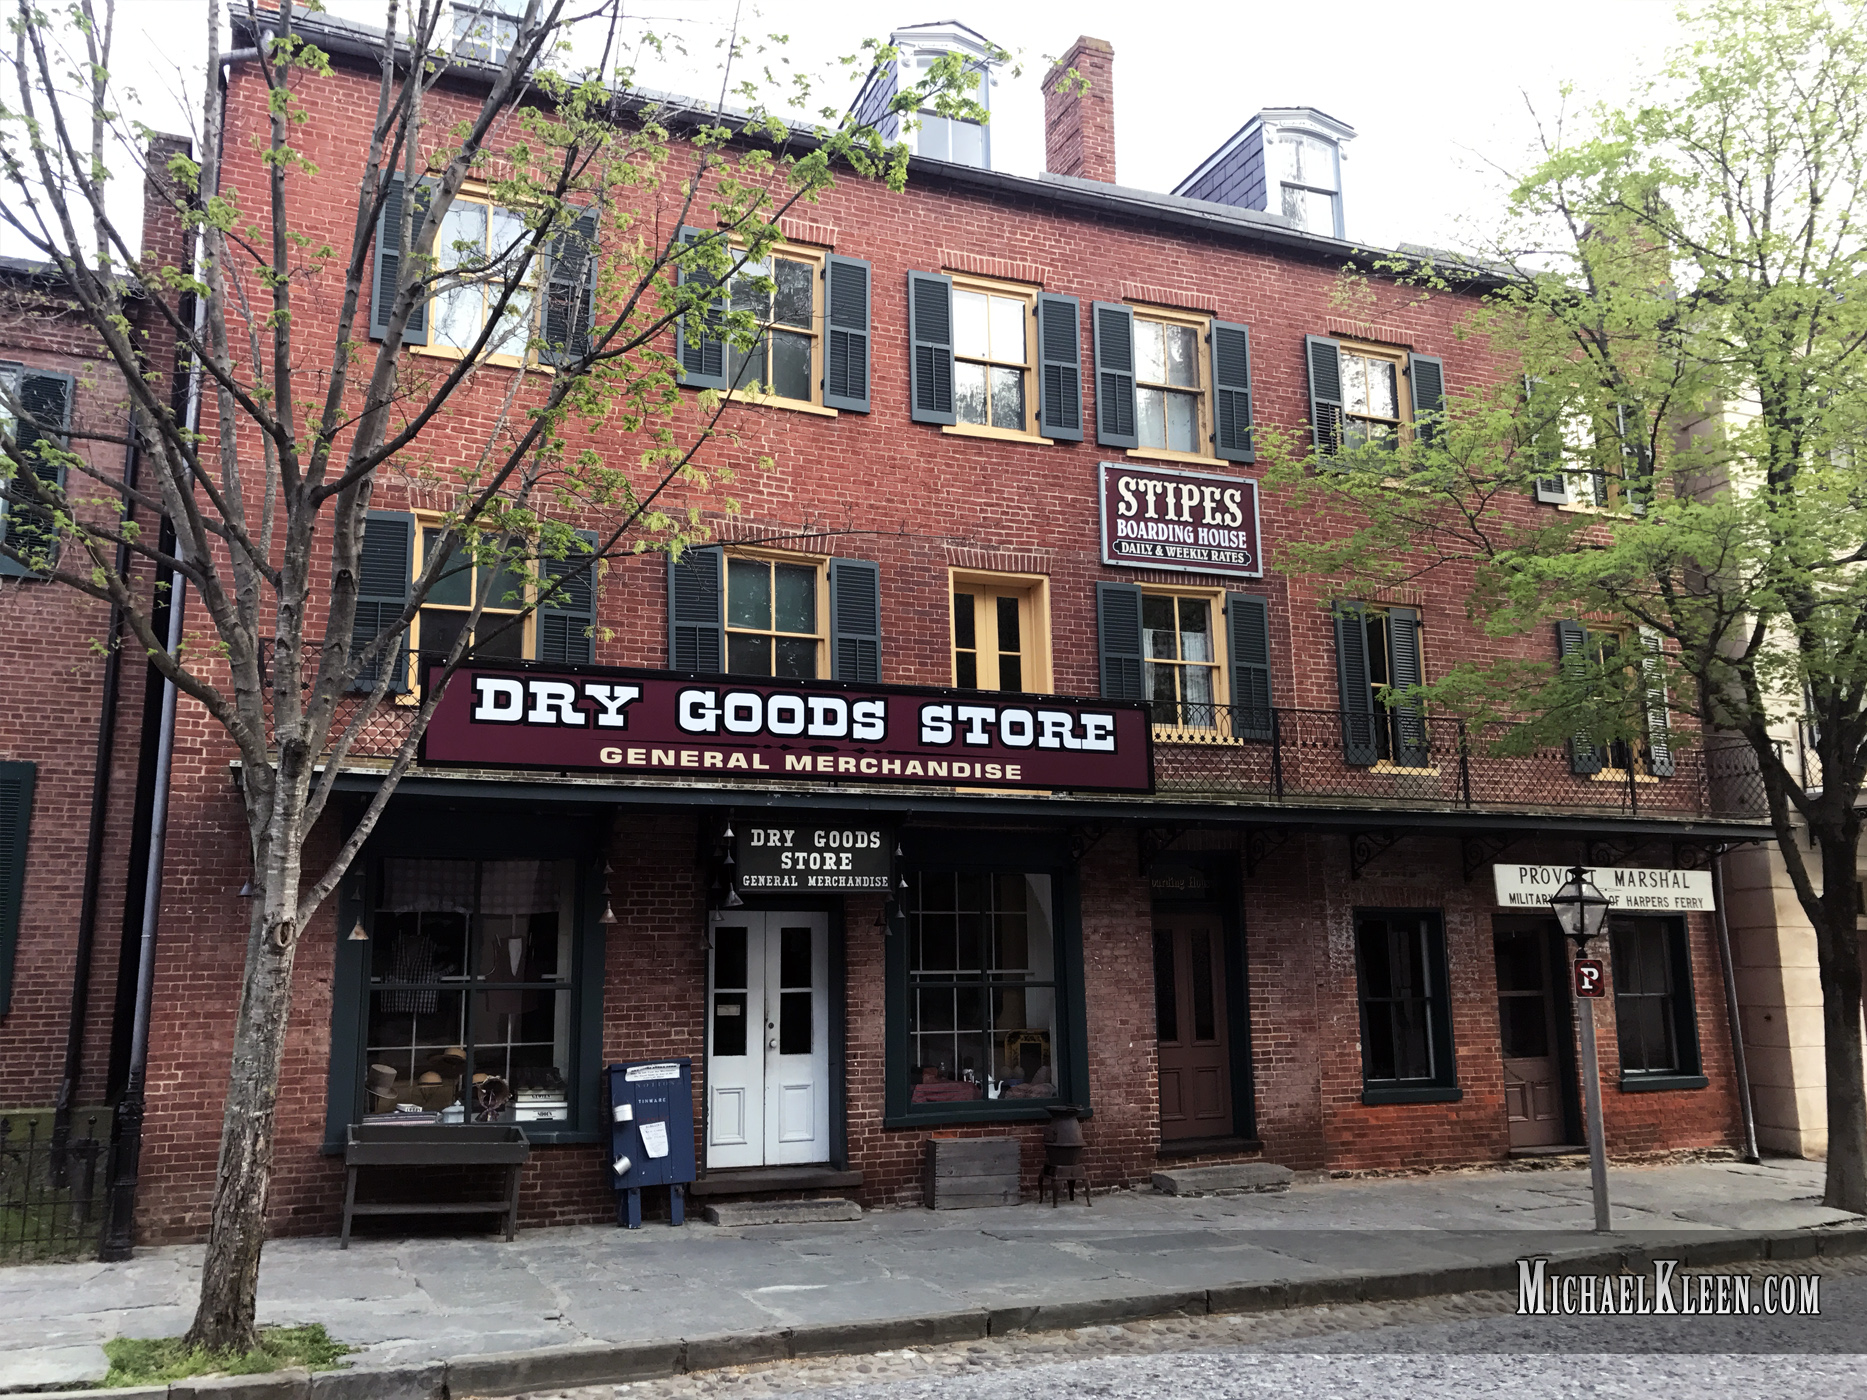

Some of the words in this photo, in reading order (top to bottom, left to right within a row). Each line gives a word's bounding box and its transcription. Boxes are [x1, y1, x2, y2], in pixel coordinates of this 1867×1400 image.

[1117, 475, 1243, 528] STIPES
[1116, 519, 1194, 544] BOARDING
[1198, 527, 1247, 549] HOUSE
[1121, 541, 1153, 556] DAILY
[1155, 545, 1164, 557] &
[1165, 546, 1209, 562] WEEKLY
[1211, 550, 1245, 564] RATES
[474, 676, 641, 728] DRY
[678, 688, 885, 742] GOODS
[921, 704, 1115, 751] STORE
[599, 746, 770, 770] GENERAL
[784, 754, 1022, 781] MERCHANDISE
[750, 828, 796, 847] DRY
[814, 830, 881, 849] GOODS
[781, 852, 852, 870] STORE
[742, 875, 798, 888] GENERAL
[807, 876, 889, 888] MERCHANDISE
[1519, 866, 1597, 885] PROVOT
[1614, 870, 1690, 889] MARSHAL
[1608, 895, 1620, 907] OF
[1626, 896, 1670, 908] HARPERS
[1674, 897, 1704, 909] FERRY
[1580, 967, 1599, 990] P
